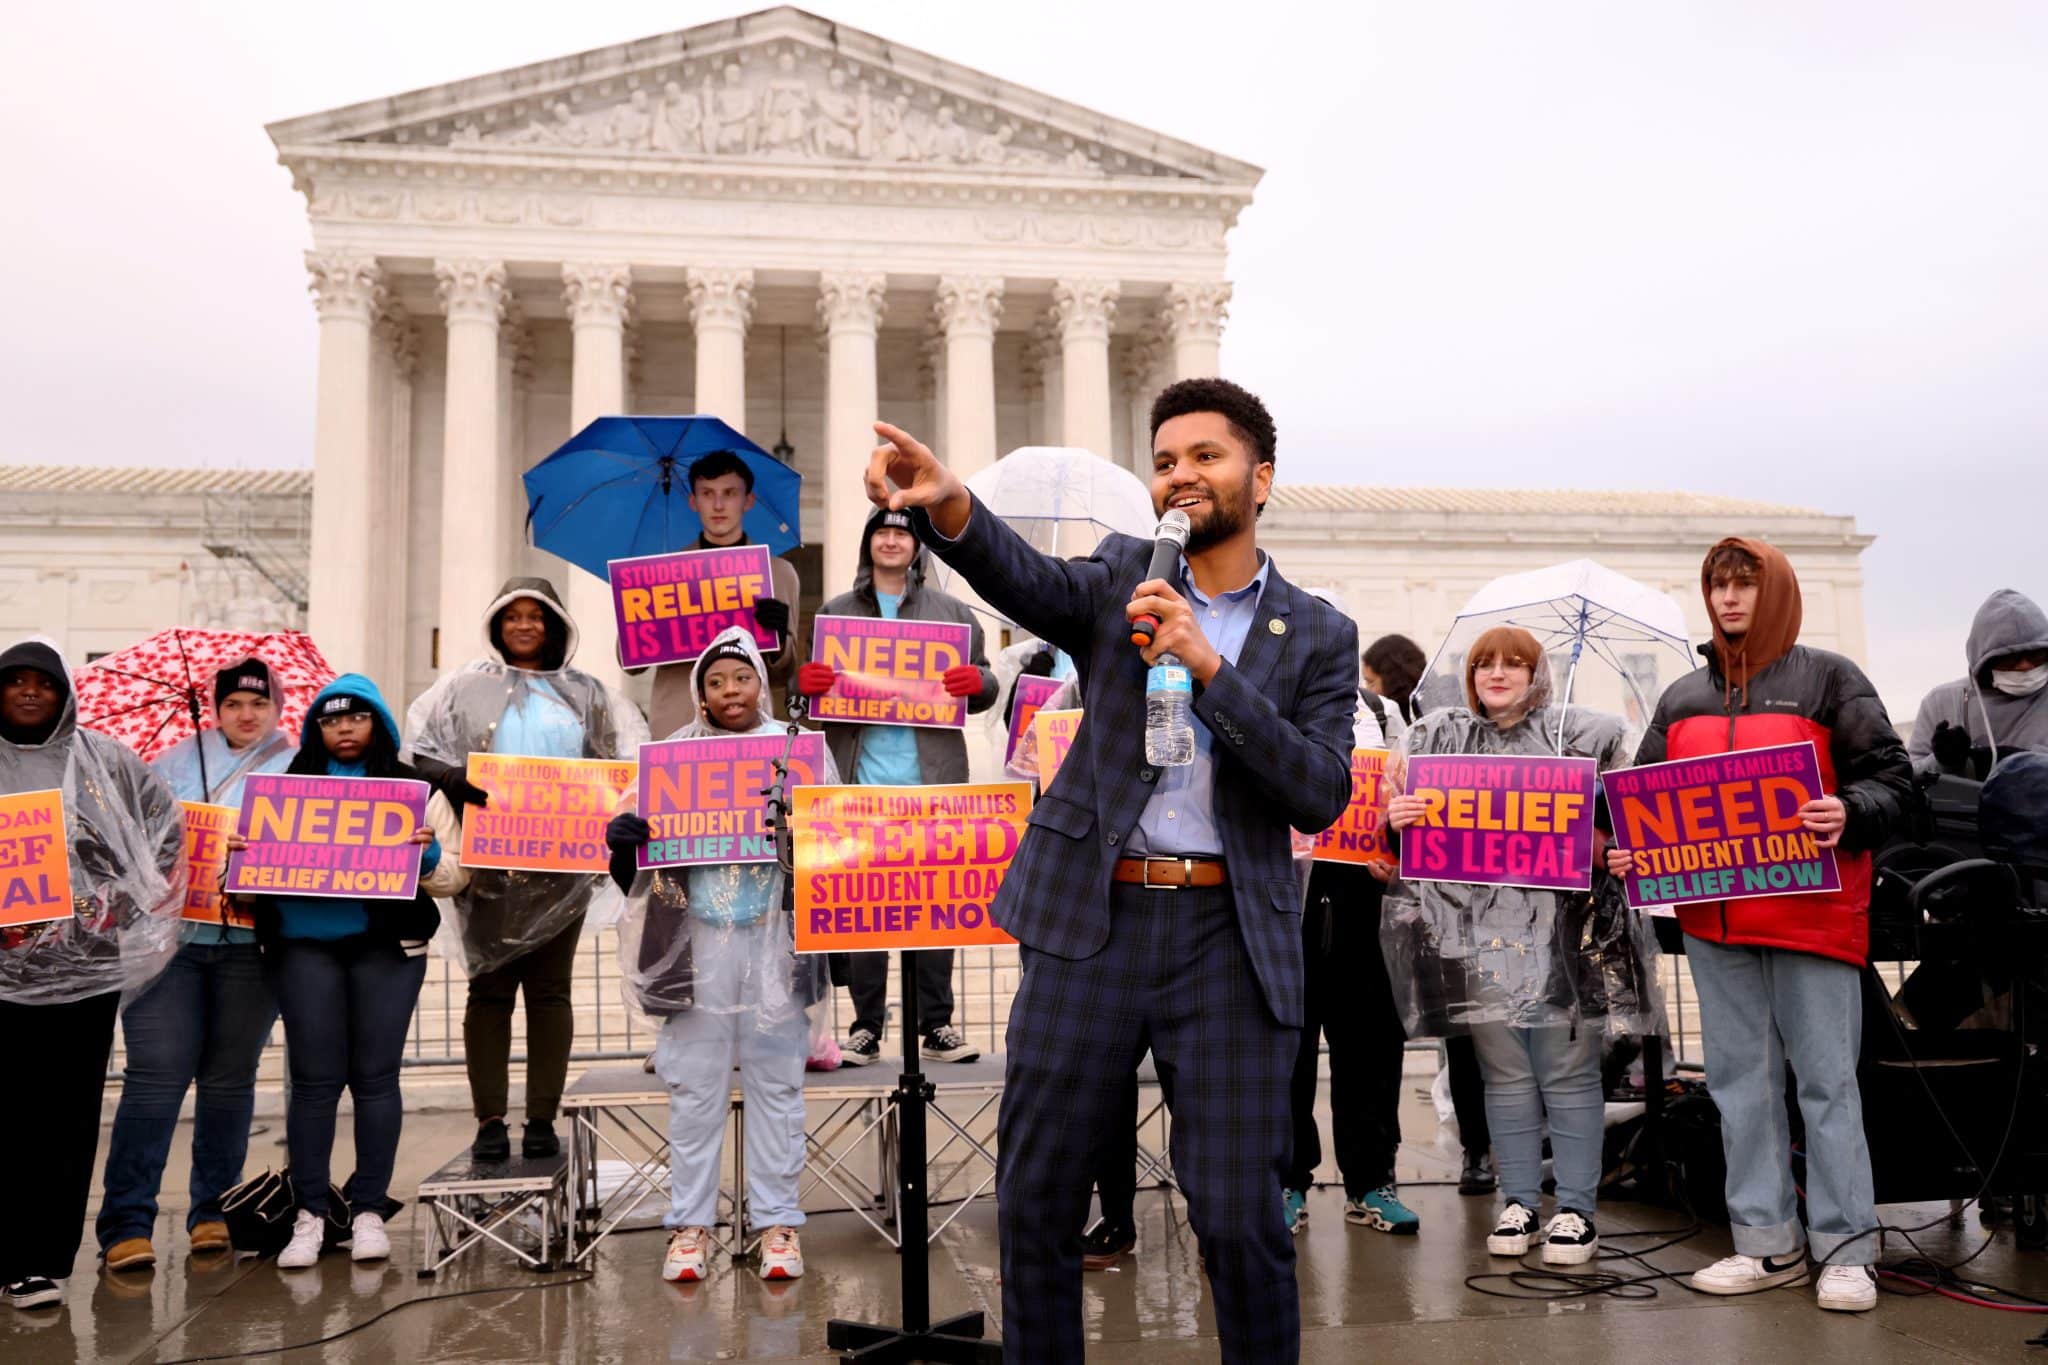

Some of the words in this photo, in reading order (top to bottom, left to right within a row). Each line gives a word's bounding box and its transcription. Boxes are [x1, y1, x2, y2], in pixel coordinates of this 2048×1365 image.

[619, 559, 706, 588] STUDENT
[711, 554, 761, 576] LOAN
[621, 574, 764, 624] RELIEF
[626, 621, 661, 660] IS
[845, 621, 899, 637] MILLION
[903, 623, 962, 641] FAMILIES
[823, 635, 961, 681] NEED
[819, 696, 893, 720] RELIEF
[896, 701, 957, 723] NOW
[1049, 719, 1068, 734] 40
[649, 748, 669, 765] 40
[673, 742, 738, 763] MILLION
[479, 761, 498, 777] 40
[503, 762, 561, 780] MILLION
[566, 765, 629, 784] FAMILIES
[648, 758, 815, 814] NEED
[1416, 763, 1515, 790] STUDENT
[1522, 765, 1584, 792] LOAN
[1616, 775, 1640, 796] 40
[1645, 763, 1719, 791] MILLION
[1724, 751, 1805, 783] FAMILIES
[255, 778, 276, 795] 40
[280, 779, 345, 798] MILLION
[350, 781, 419, 801] FAMILIES
[247, 796, 416, 847] NEED
[809, 797, 835, 819] 40
[843, 795, 923, 817] MILLION
[930, 793, 1017, 816] FAMILIES
[1413, 787, 1585, 834] RELIEF
[1621, 776, 1811, 849] NEED
[475, 814, 566, 840] STUDENT
[647, 809, 748, 840] STUDENT
[243, 842, 344, 869] STUDENT
[351, 846, 408, 871] LOAN
[472, 836, 554, 859] RELIEF
[559, 841, 611, 861] NO
[647, 836, 735, 863] RELIEF
[809, 818, 1019, 869] NEED
[1410, 829, 1448, 871] IS
[1462, 831, 1583, 879] LEGAL
[1633, 838, 1744, 877] STUDENT
[1752, 831, 1820, 864] LOAN
[238, 865, 330, 890] RELIEF
[331, 870, 407, 893] NOW
[810, 870, 938, 904] STUDENT
[949, 868, 1008, 900] LOA
[1637, 869, 1736, 903] RELIEF
[1743, 861, 1823, 892] NOW
[810, 904, 923, 934] RELIEF
